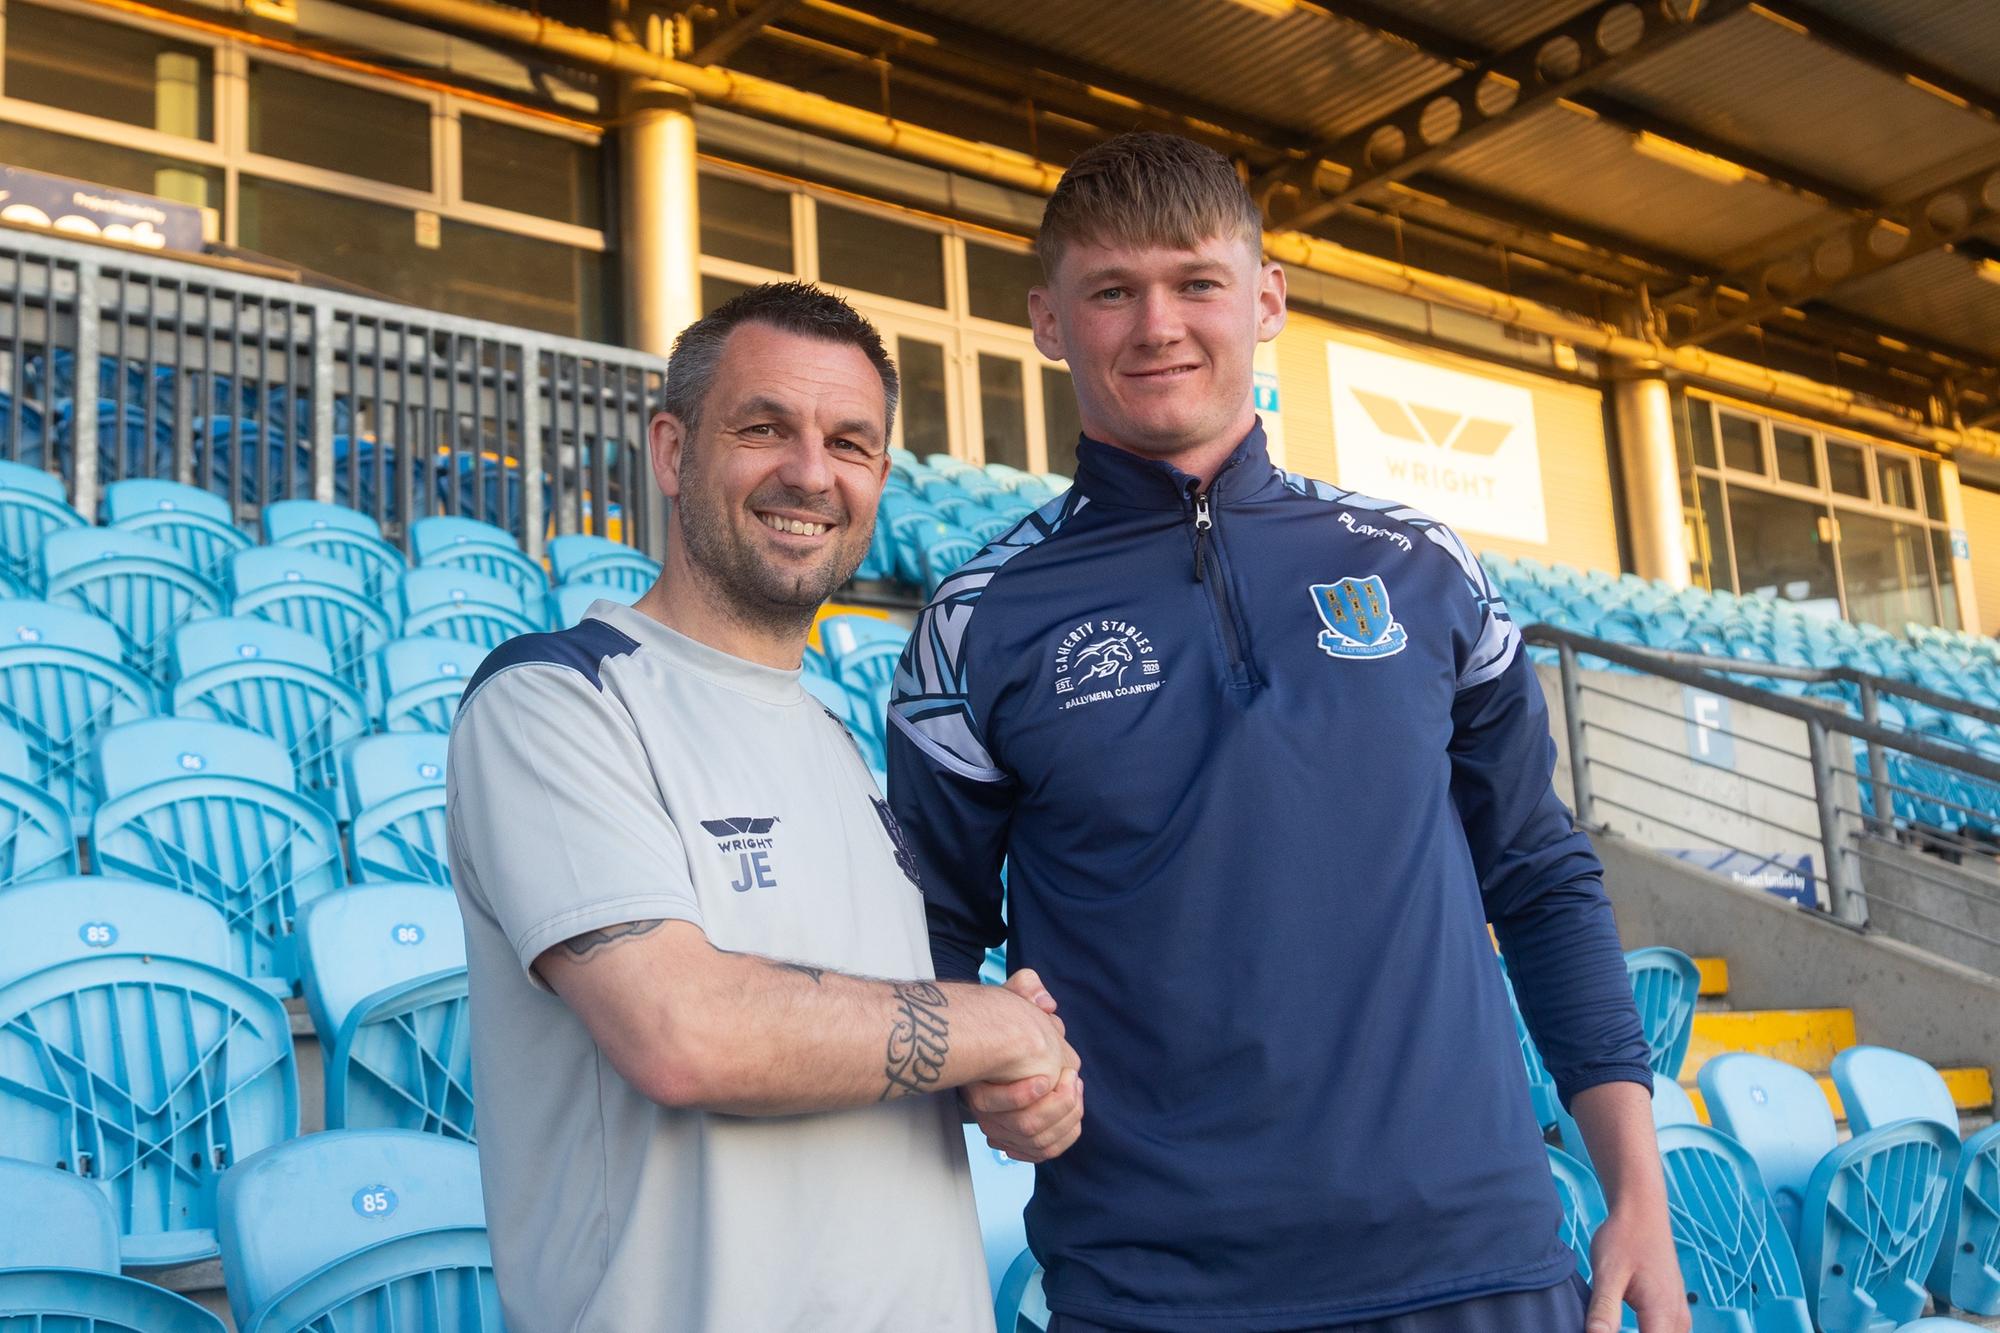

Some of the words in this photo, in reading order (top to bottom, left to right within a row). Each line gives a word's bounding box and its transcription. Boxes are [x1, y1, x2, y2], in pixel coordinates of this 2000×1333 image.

[1385, 457, 1497, 499] WRIGHT
[1055, 622, 1094, 673] CAHERTY
[1101, 620, 1153, 654] STABLES
[1142, 663, 1160, 673] 2020
[1056, 679, 1074, 692] EST.
[1065, 690, 1114, 709] BALLYMENA
[1694, 697, 1719, 755] F
[717, 838, 773, 853] WRIGHT
[731, 851, 777, 892] JE
[87, 926, 110, 941] 85
[398, 927, 418, 942] 86
[363, 1192, 388, 1212] 85
